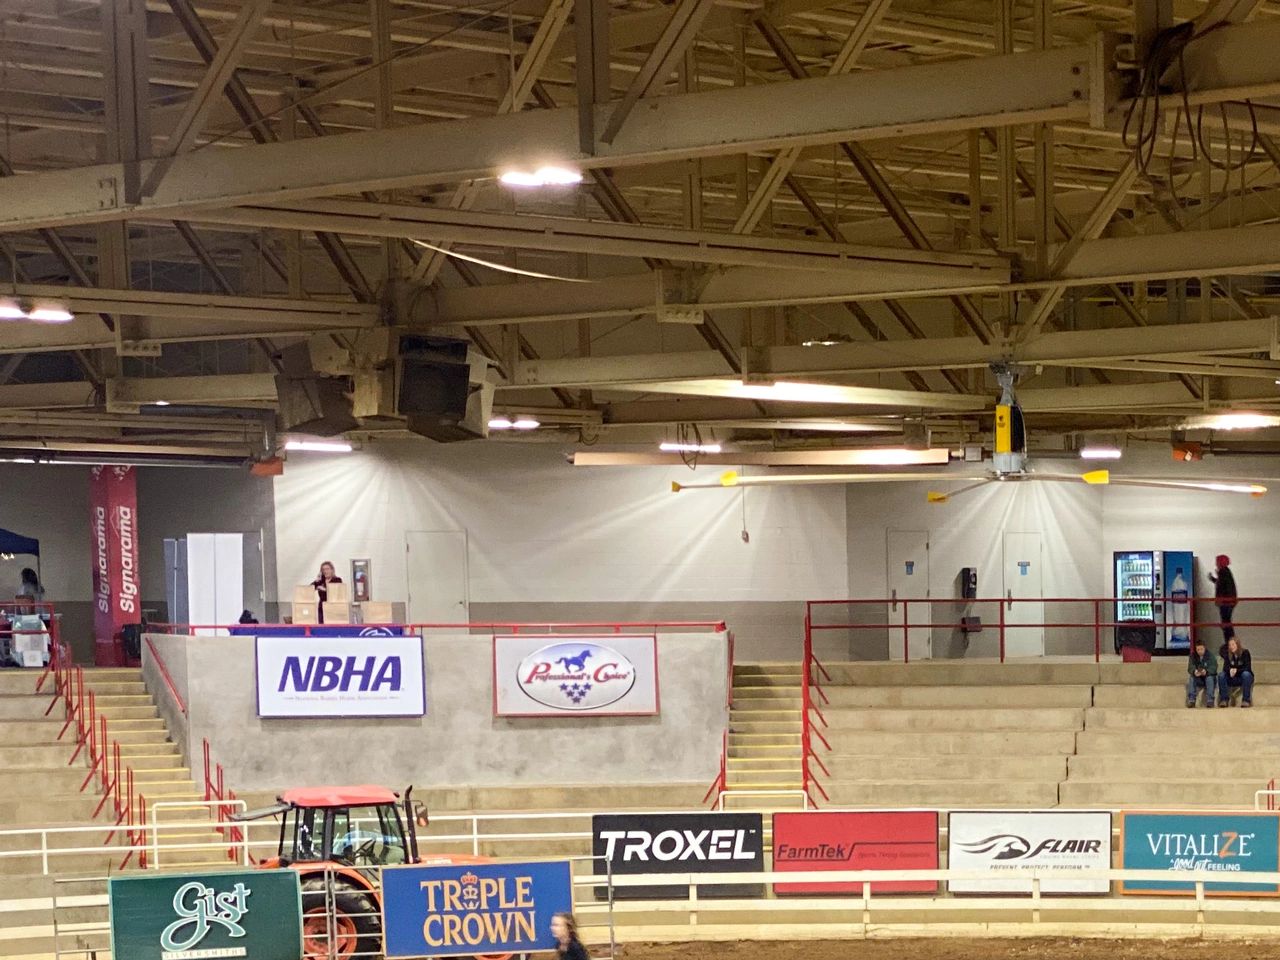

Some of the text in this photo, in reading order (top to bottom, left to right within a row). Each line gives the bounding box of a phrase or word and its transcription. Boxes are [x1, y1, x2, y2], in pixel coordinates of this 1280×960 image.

[119, 505, 137, 613] Signarama
[278, 656, 402, 692] NBHA
[593, 663, 628, 683] Choice
[599, 829, 756, 861] TROXEL
[777, 844, 846, 859] FarmTek
[1022, 838, 1102, 859] FLAIR
[1146, 831, 1252, 858] VITALIZE
[1207, 863, 1241, 872] FEELING
[160, 881, 250, 951] Gist
[423, 911, 536, 947] CROWN
